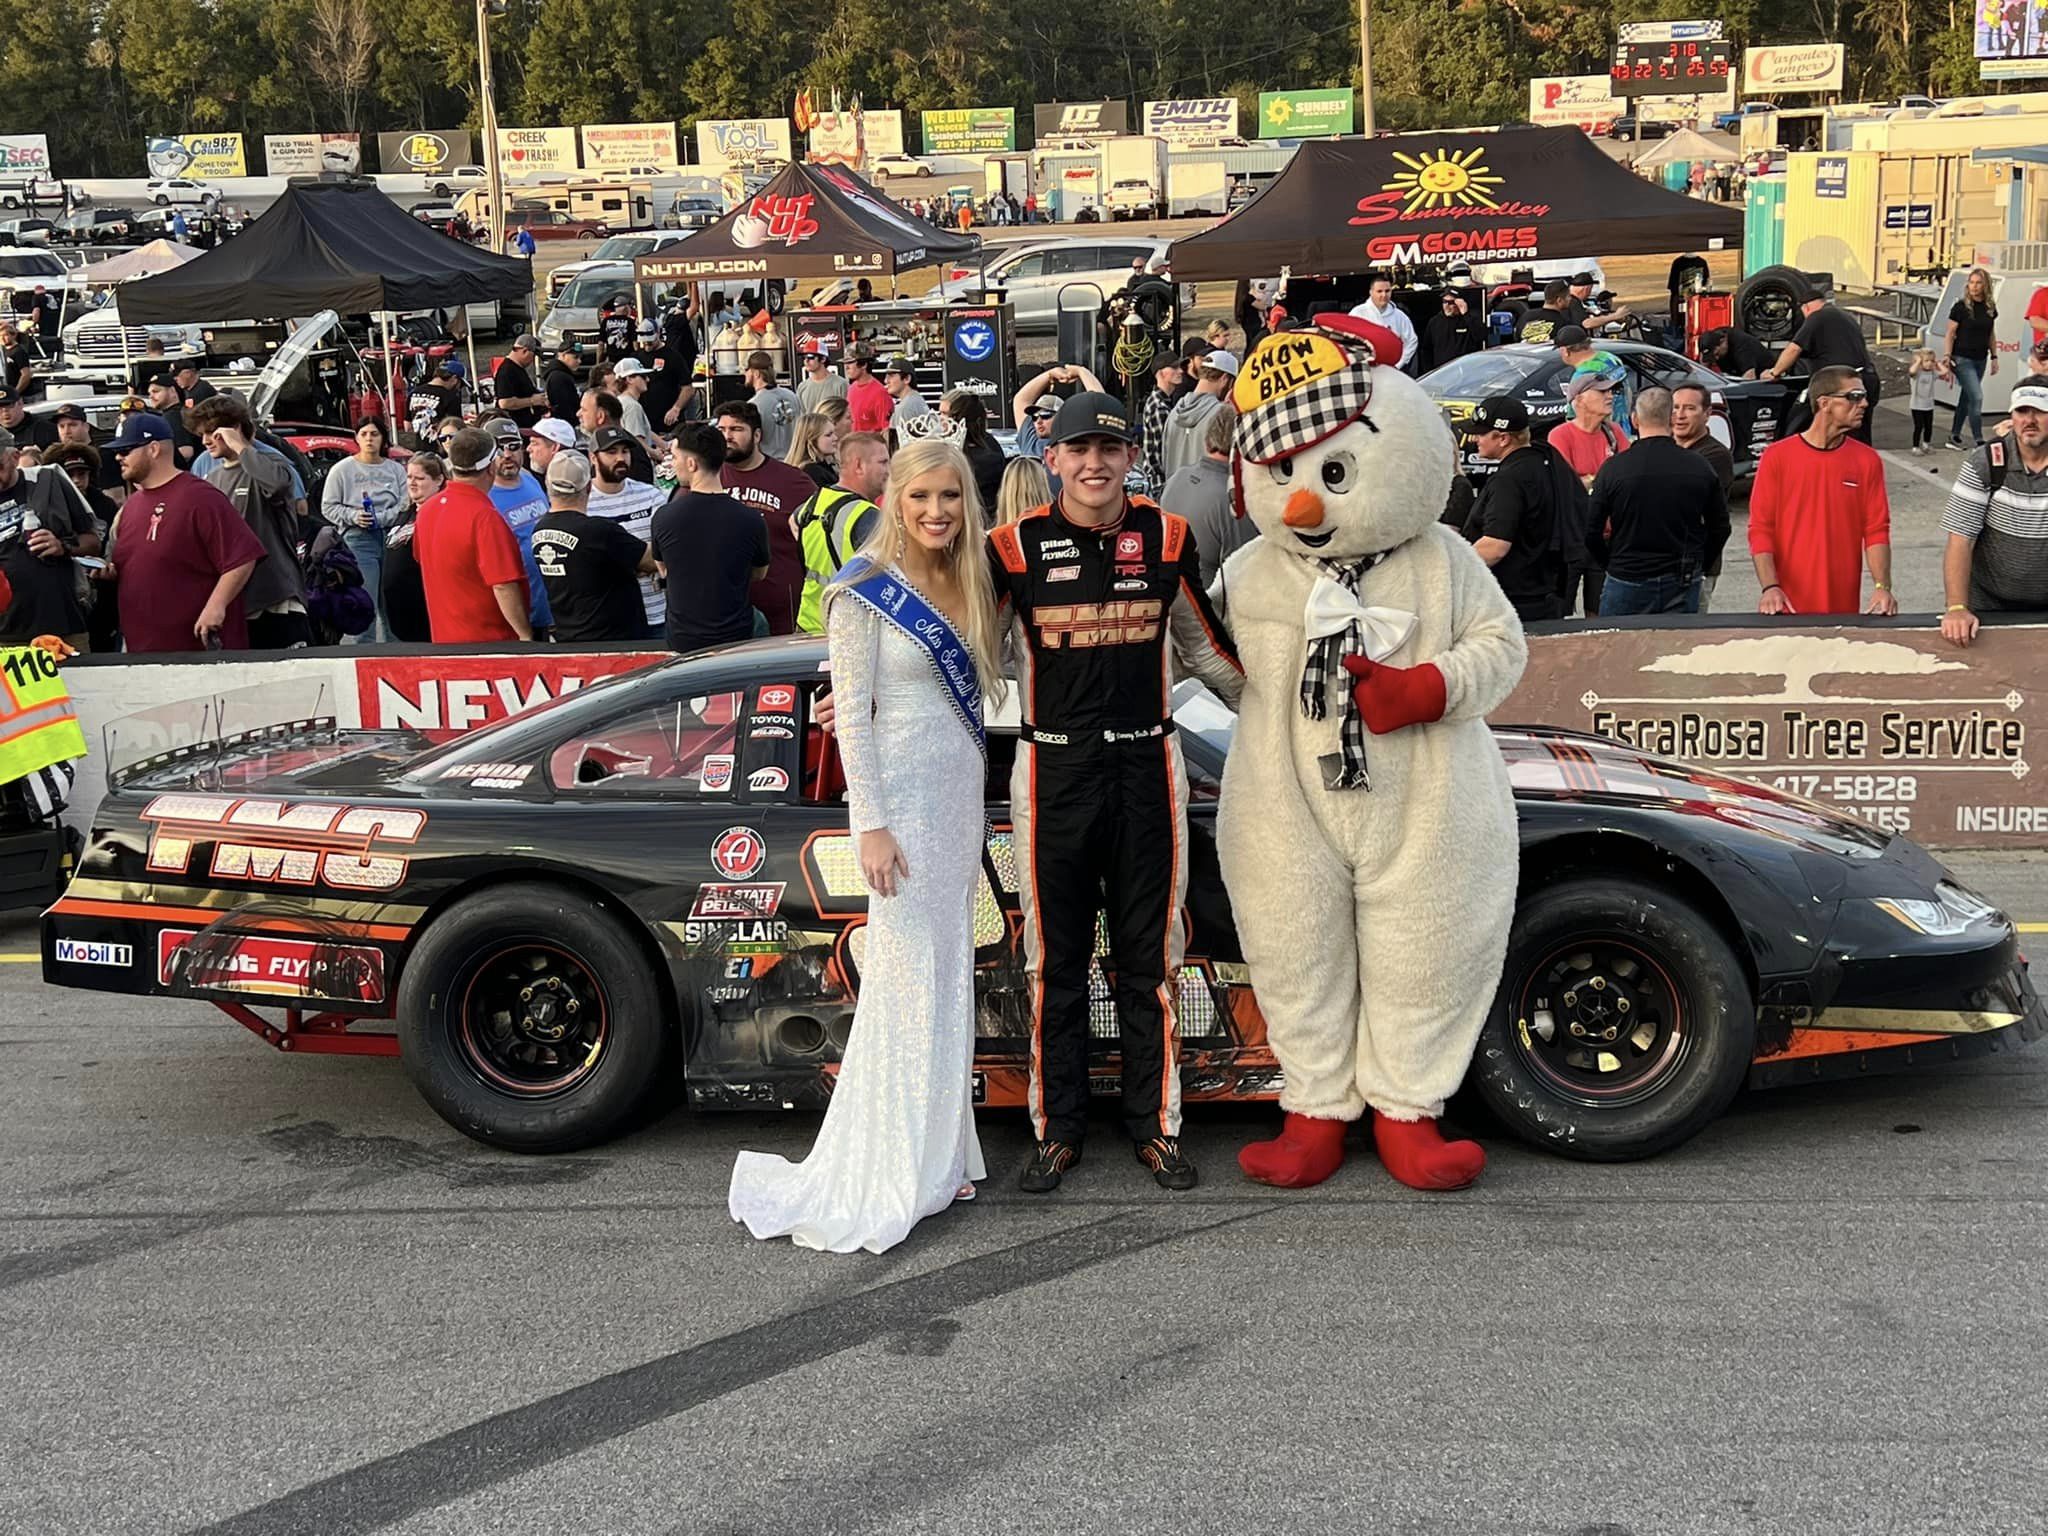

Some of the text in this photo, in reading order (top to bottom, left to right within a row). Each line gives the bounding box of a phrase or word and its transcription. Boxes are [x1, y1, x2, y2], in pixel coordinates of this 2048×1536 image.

[1635, 64, 1653, 79] 22
[1659, 64, 1677, 77] 51
[1687, 62, 1705, 76] 25
[1710, 61, 1728, 75] 53
[926, 111, 945, 123] WE
[1151, 101, 1230, 116] SMITH
[507, 131, 547, 143] CREEK
[1422, 227, 1537, 253] GOMES
[1423, 246, 1538, 264] MOTORSPORTS
[641, 259, 767, 277] NUTUP.COM
[1249, 337, 1315, 381] SNOW
[1260, 362, 1323, 401] BALL
[742, 487, 781, 510] JONES
[915, 618, 943, 649] Miss
[1032, 599, 1163, 649] TMC
[5, 649, 58, 687] 116
[750, 715, 796, 727] TOYOTA
[1592, 710, 2024, 761] EscaRosa Tree Service
[139, 796, 428, 891] TMC
[57, 941, 132, 966] Mobil 1
